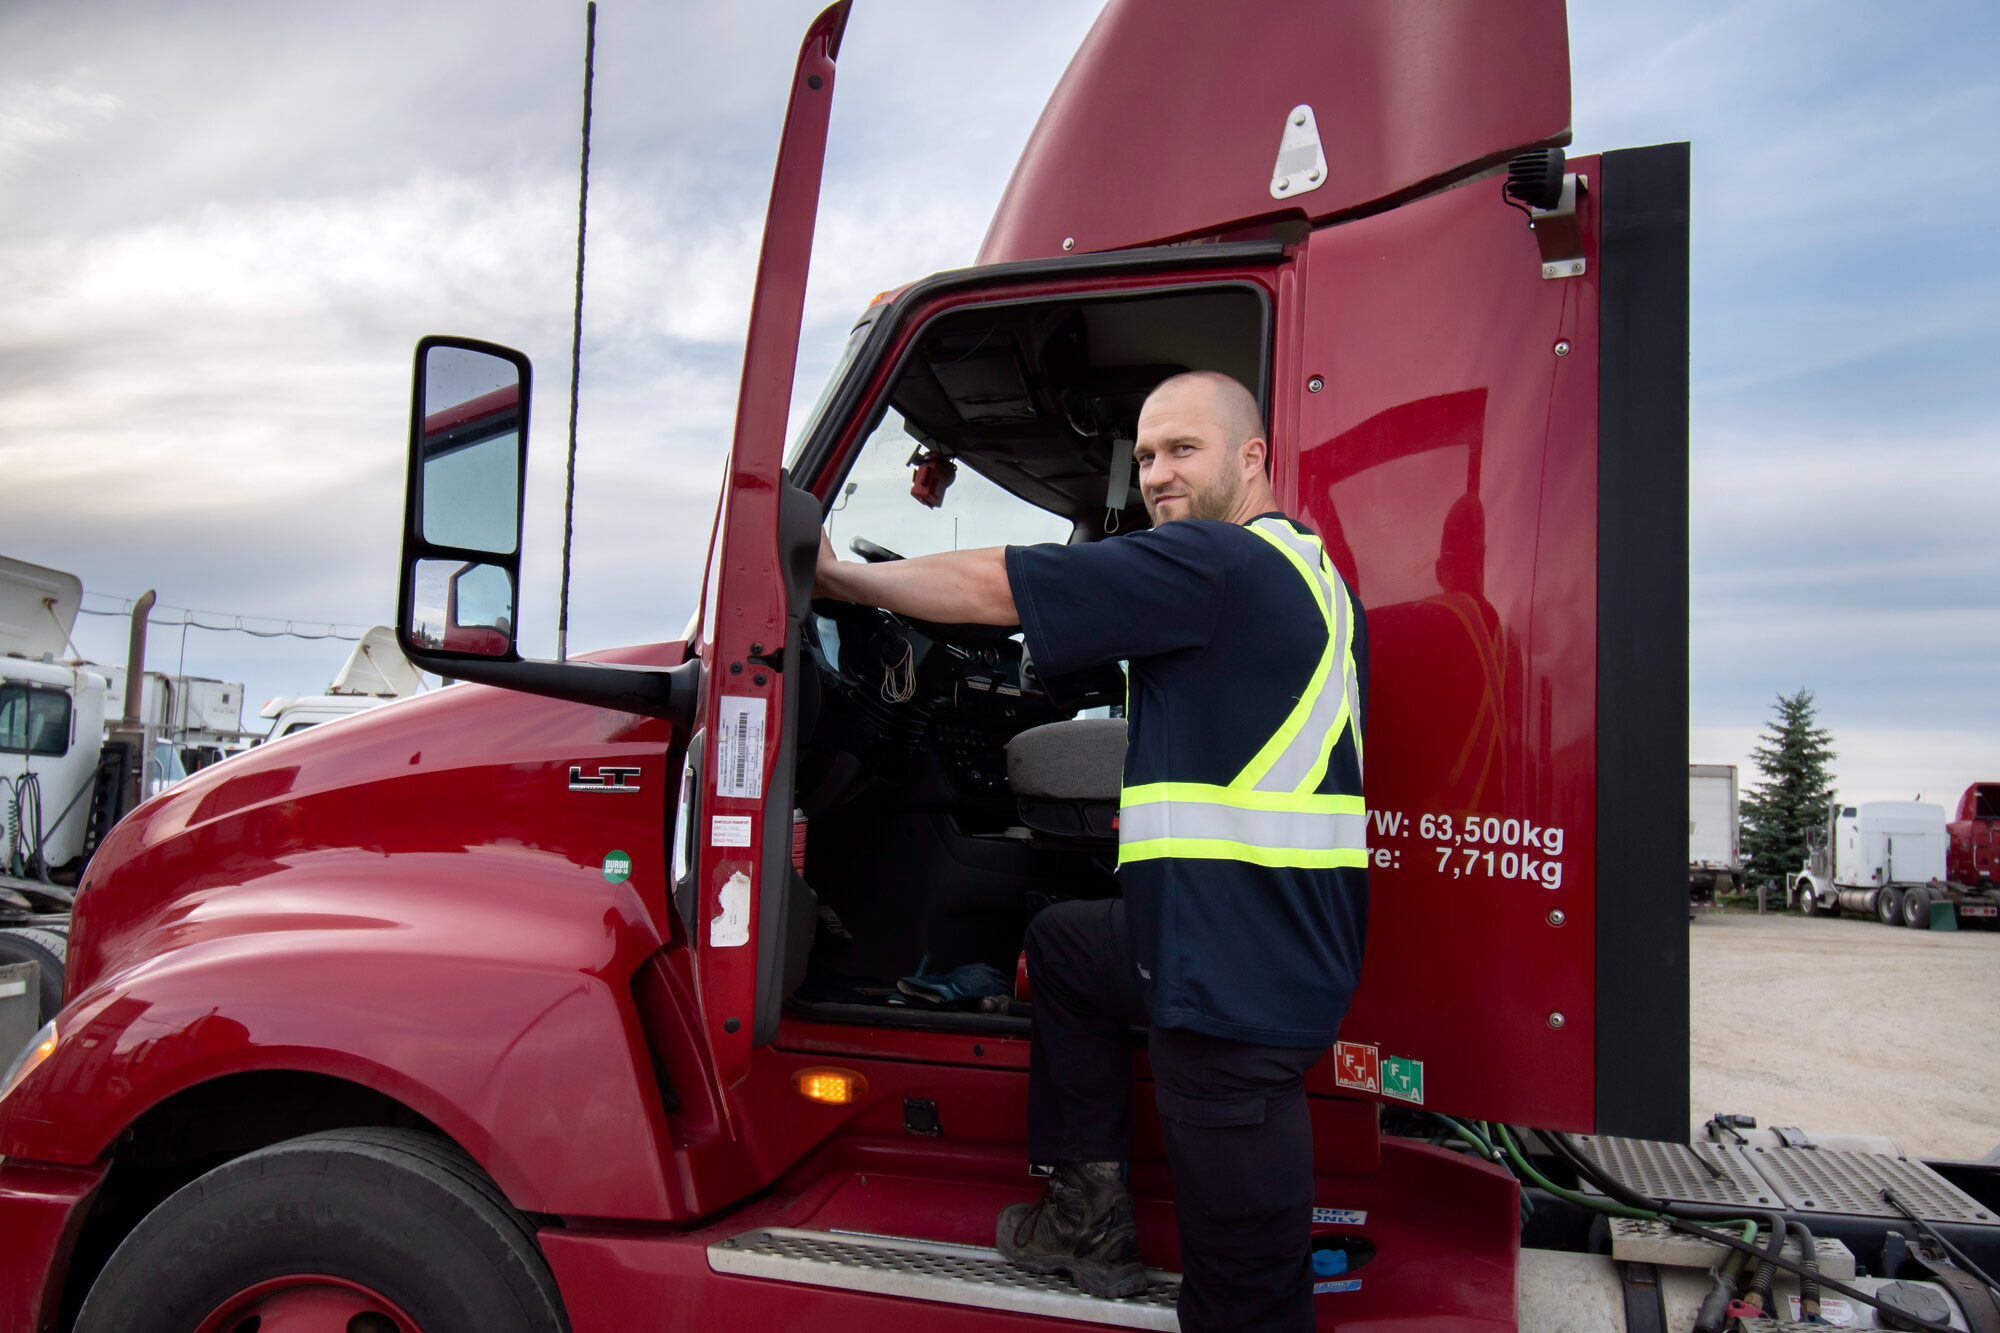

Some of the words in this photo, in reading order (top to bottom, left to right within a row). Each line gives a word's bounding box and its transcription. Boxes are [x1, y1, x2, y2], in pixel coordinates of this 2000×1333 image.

[568, 766, 641, 786] LT
[1419, 813, 1564, 856] 63,500kg
[605, 859, 629, 869] DURON
[1435, 847, 1563, 890] 7,710kg
[1366, 1047, 1376, 1055] 21
[1316, 1208, 1356, 1216] DEF
